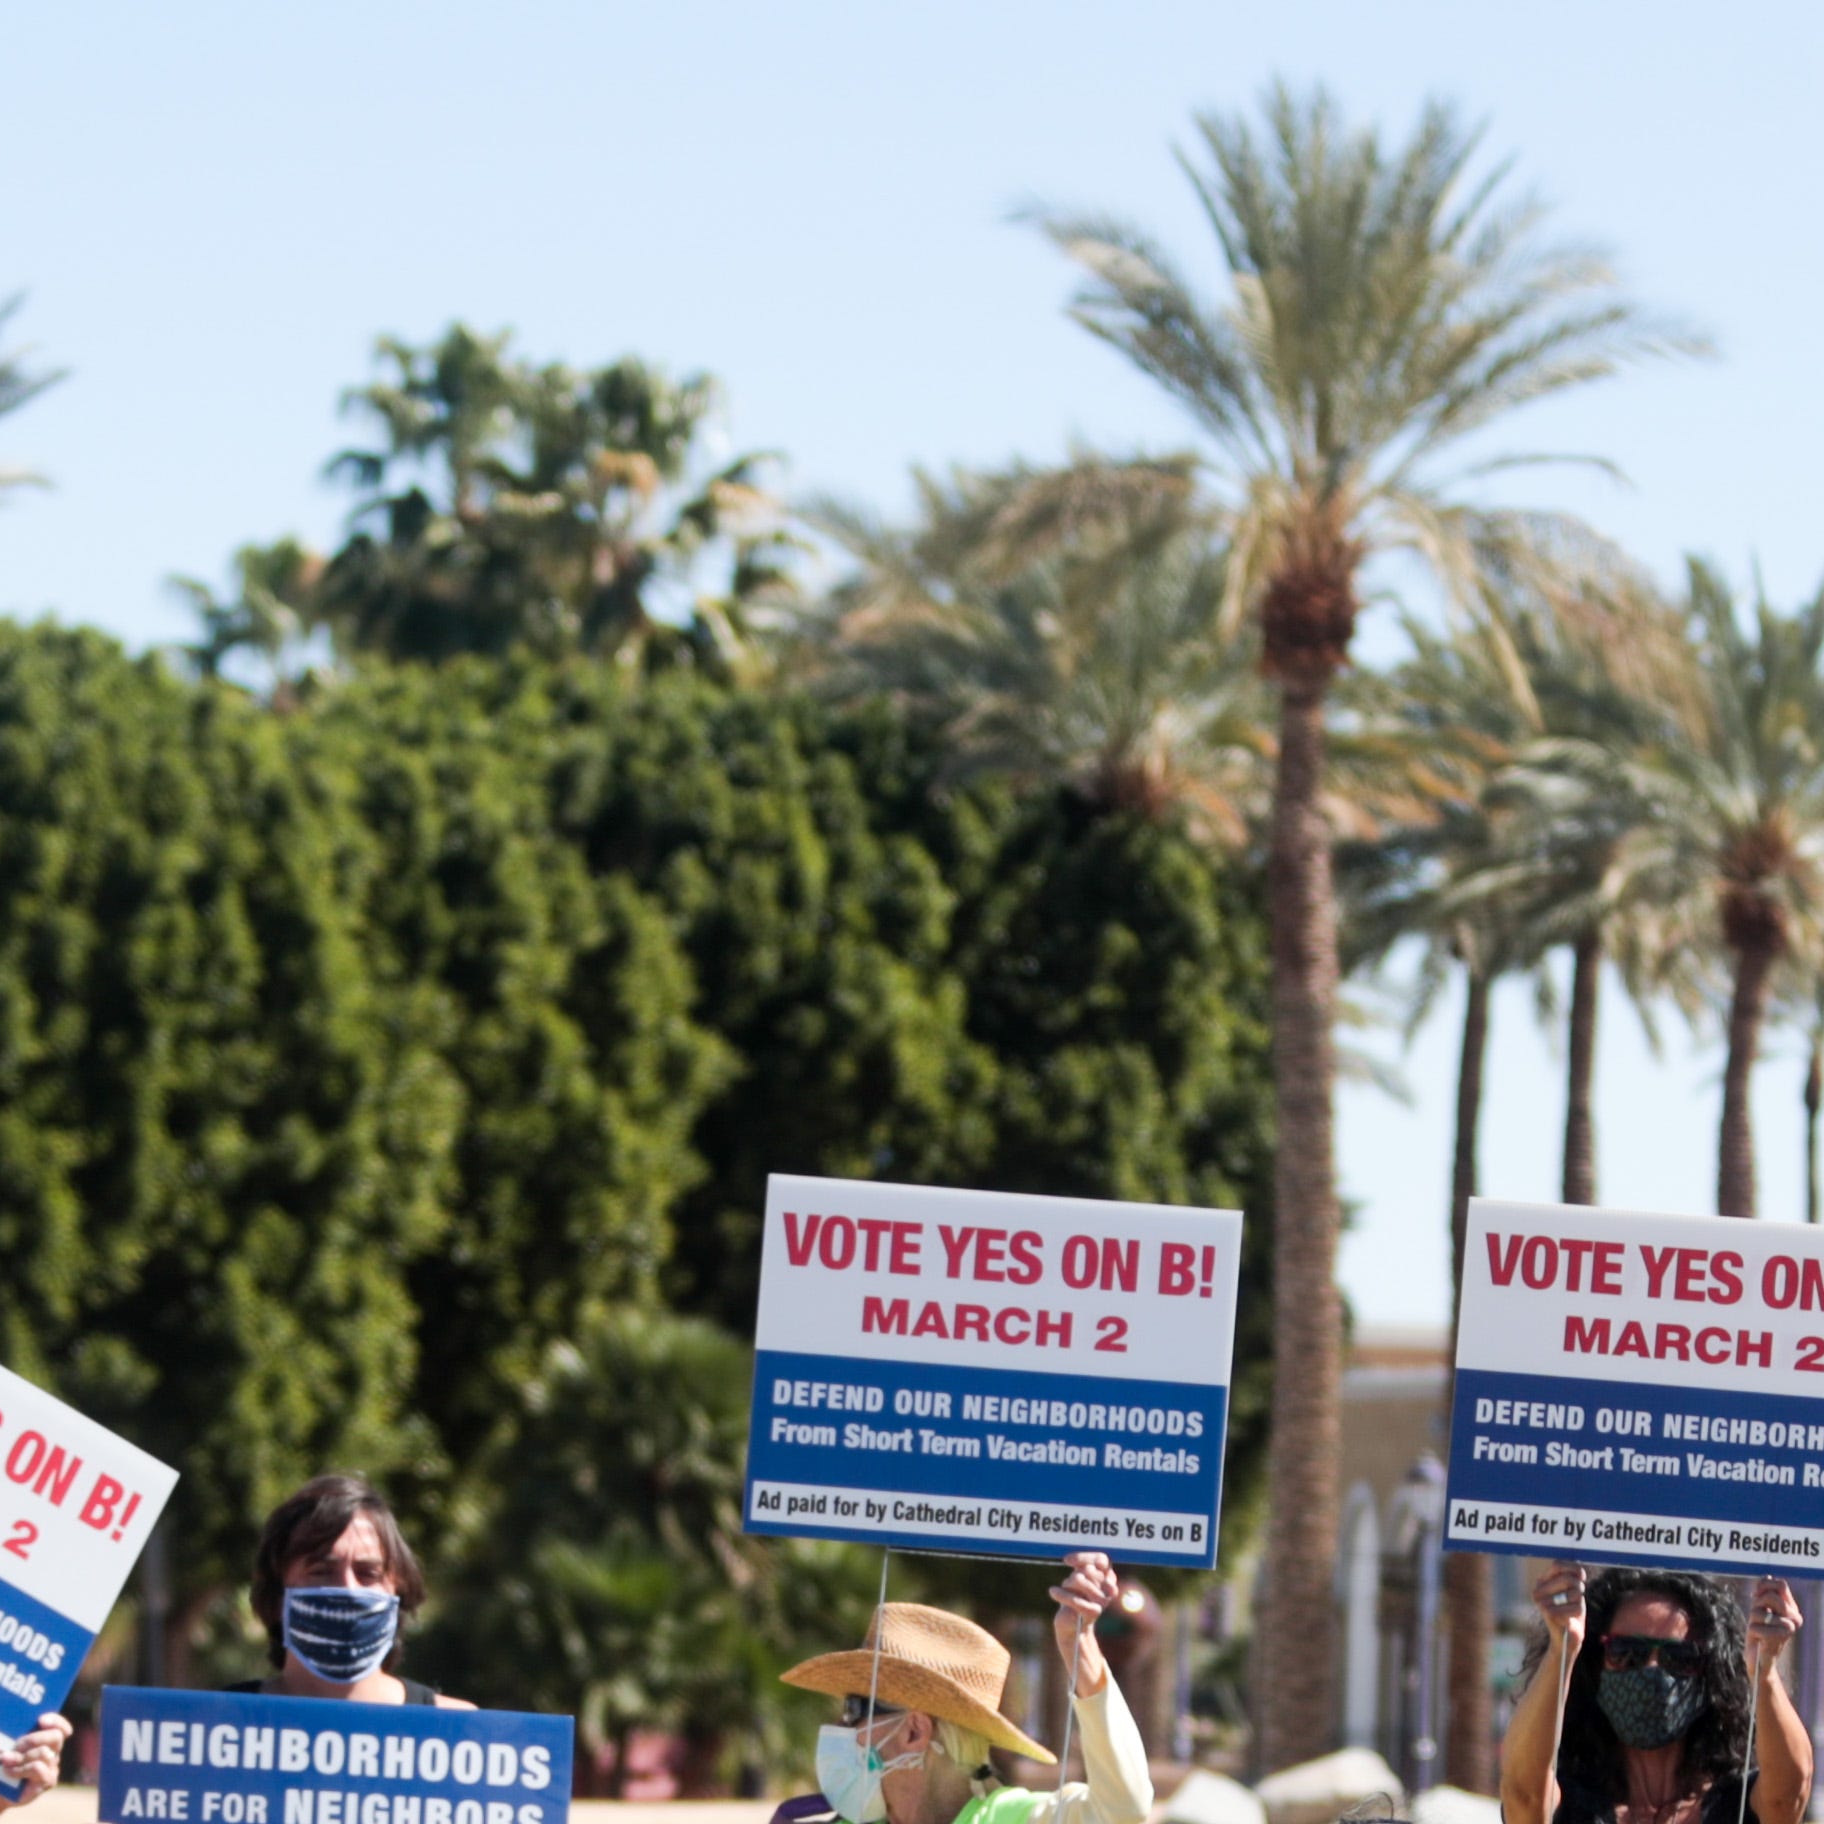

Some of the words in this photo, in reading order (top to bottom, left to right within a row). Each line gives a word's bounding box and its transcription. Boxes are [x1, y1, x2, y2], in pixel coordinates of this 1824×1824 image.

[1486, 1232, 1624, 1296] VOTE
[1640, 1245, 1744, 1306] YES
[773, 1380, 884, 1412] DEFEND
[894, 1388, 952, 1419] OUR
[963, 1395, 1203, 1438] NEIGHBORHOODS
[771, 1418, 836, 1447] From
[844, 1424, 913, 1453] Short
[919, 1430, 981, 1458] Term
[987, 1435, 1096, 1466] Vacation
[1104, 1445, 1200, 1475] Rentals
[5, 1430, 82, 1507] ON
[79, 1473, 142, 1543] B!
[121, 1719, 551, 1790] NEIGHBORHOODS
[121, 1788, 188, 1820] ARE
[203, 1792, 268, 1824] FOR
